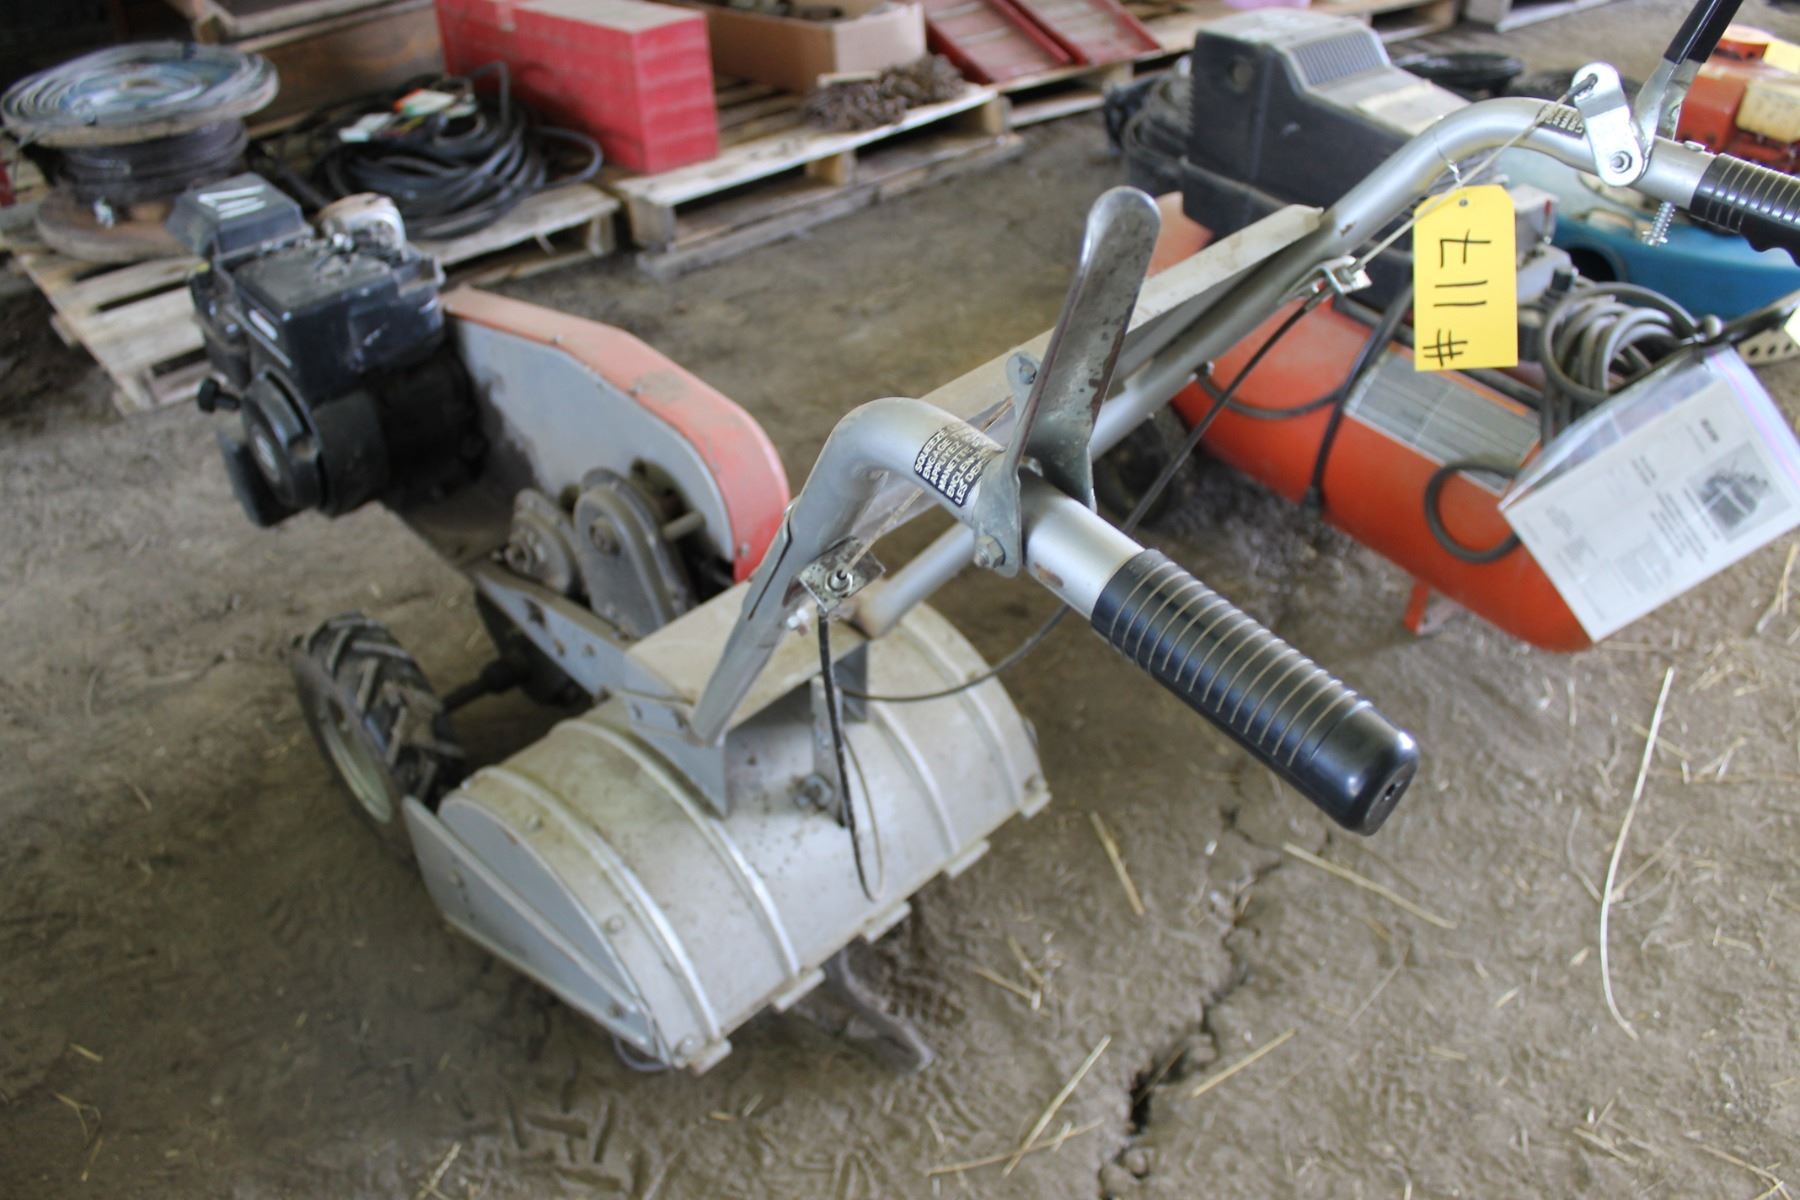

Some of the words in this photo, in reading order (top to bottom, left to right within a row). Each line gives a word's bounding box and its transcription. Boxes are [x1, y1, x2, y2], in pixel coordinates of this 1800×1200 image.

[914, 430, 947, 473] SQUEEZE
[922, 438, 952, 480] ENGAGE
[930, 441, 962, 485] APPUYEZ
